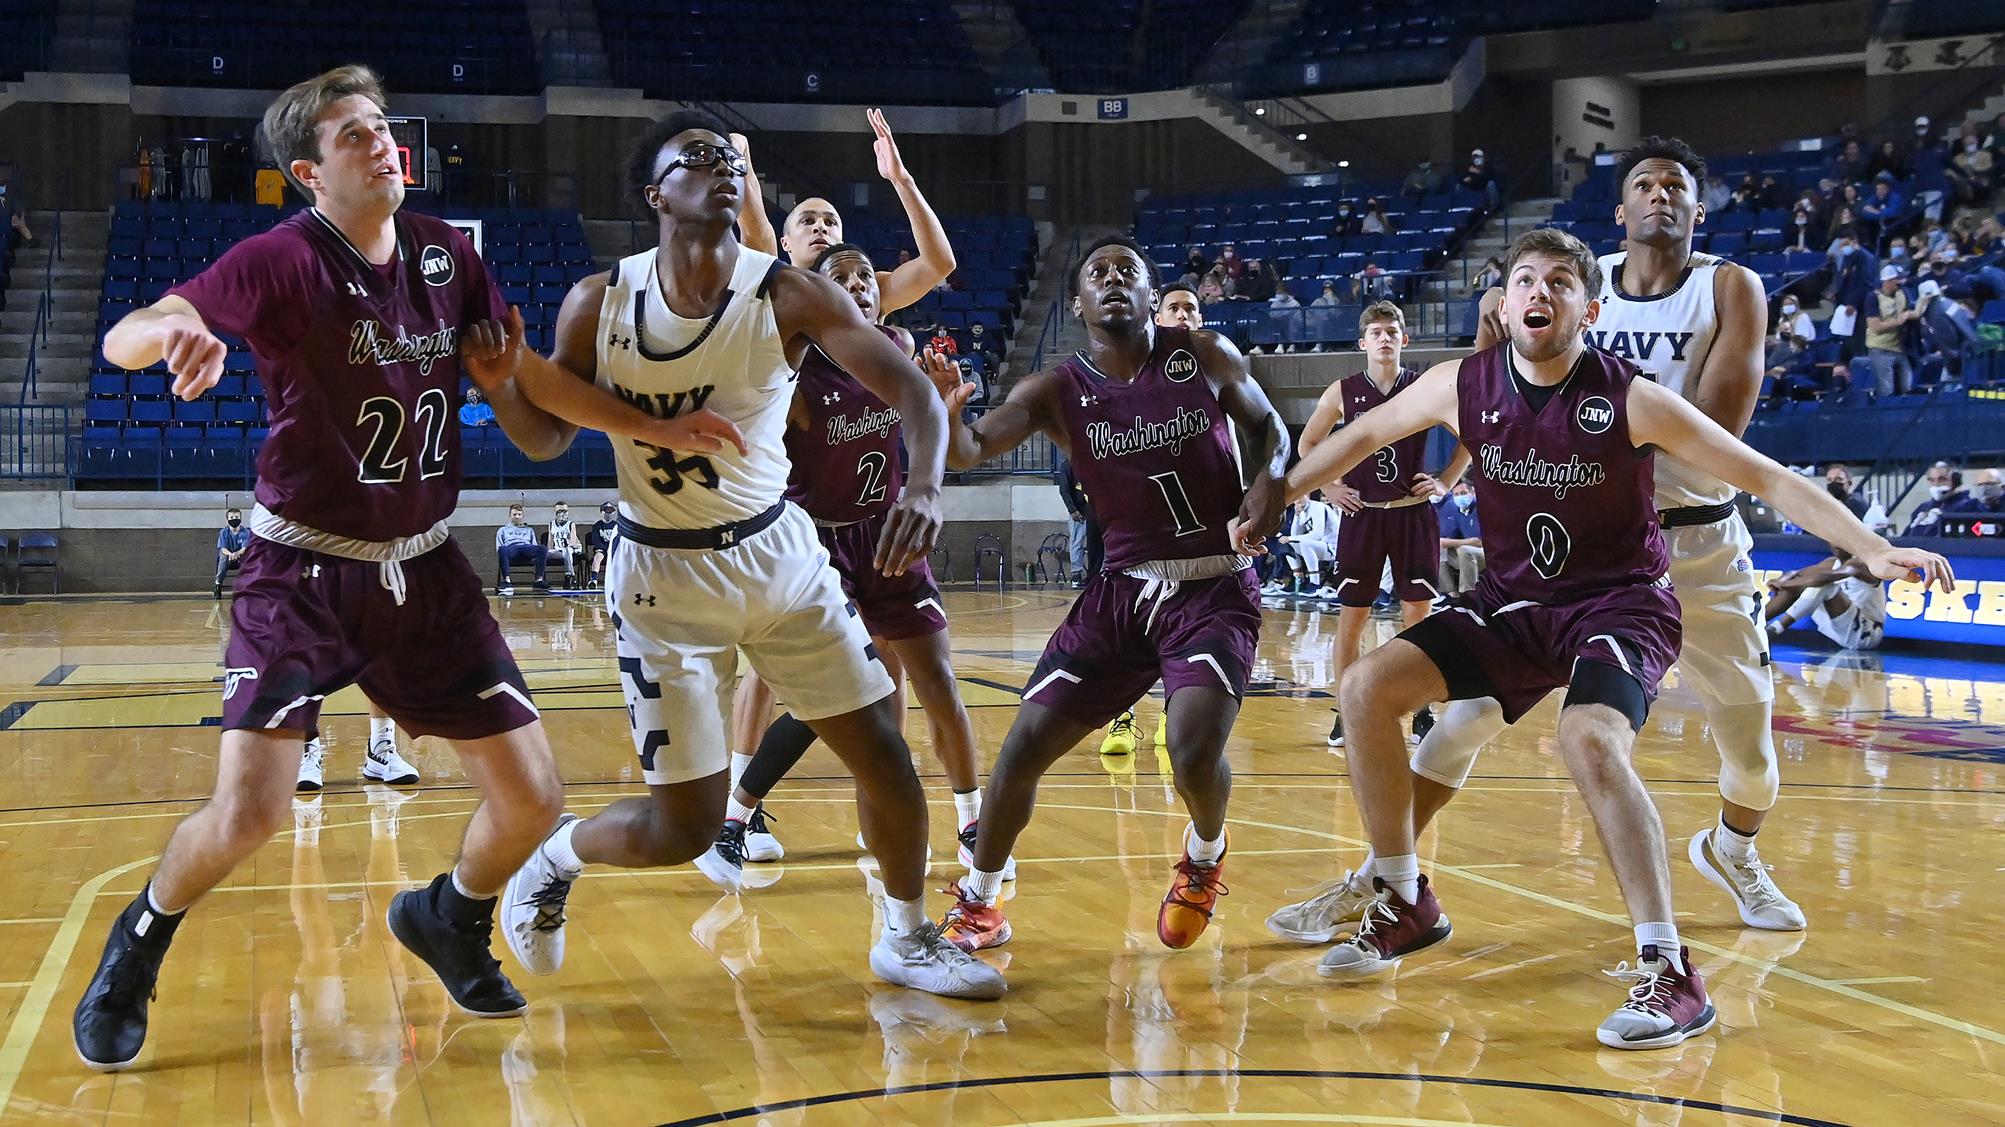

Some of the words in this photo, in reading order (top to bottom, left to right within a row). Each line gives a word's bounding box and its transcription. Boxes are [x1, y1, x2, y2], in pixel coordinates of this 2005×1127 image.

[213, 56, 224, 69] D
[453, 64, 464, 77] D
[1306, 66, 1317, 79] B
[807, 74, 818, 87] C
[1103, 101, 1122, 113] BB
[423, 255, 450, 276] JNW
[1168, 358, 1193, 373] JNW
[827, 406, 901, 445] Washing
[1580, 406, 1612, 424] JNW
[356, 388, 449, 484] 22
[1086, 406, 1210, 460] Washington
[1374, 446, 1398, 483] 3
[1480, 443, 1606, 500] Washington
[855, 451, 887, 506] 2
[1147, 470, 1208, 537] 1
[720, 530, 734, 545] N
[1526, 512, 1571, 580] 0
